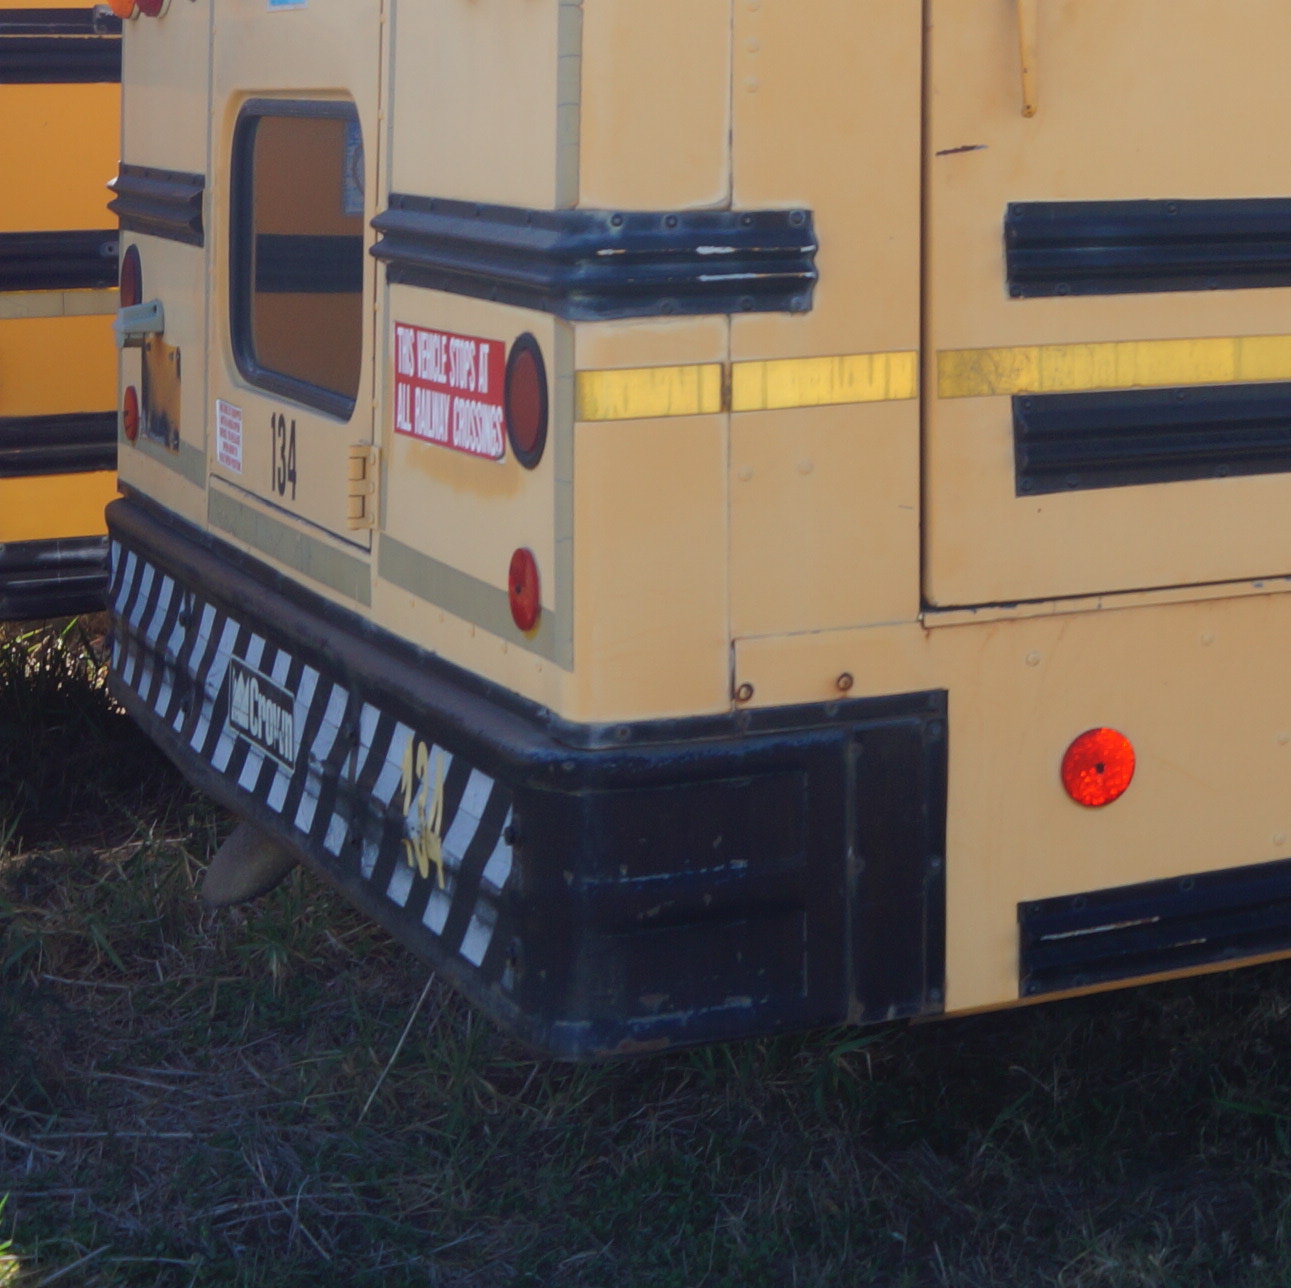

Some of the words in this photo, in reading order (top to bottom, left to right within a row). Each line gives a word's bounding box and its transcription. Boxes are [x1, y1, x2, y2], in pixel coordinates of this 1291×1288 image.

[397, 327, 415, 378] THIS
[417, 330, 447, 385] VEHICLE
[449, 337, 476, 392] STOPS
[478, 343, 489, 394] AT
[271, 412, 297, 500] 134
[397, 382, 412, 431] ALL
[414, 387, 450, 443] RAILWAY
[453, 396, 503, 457] CROSSINGS
[249, 677, 293, 762] Crown
